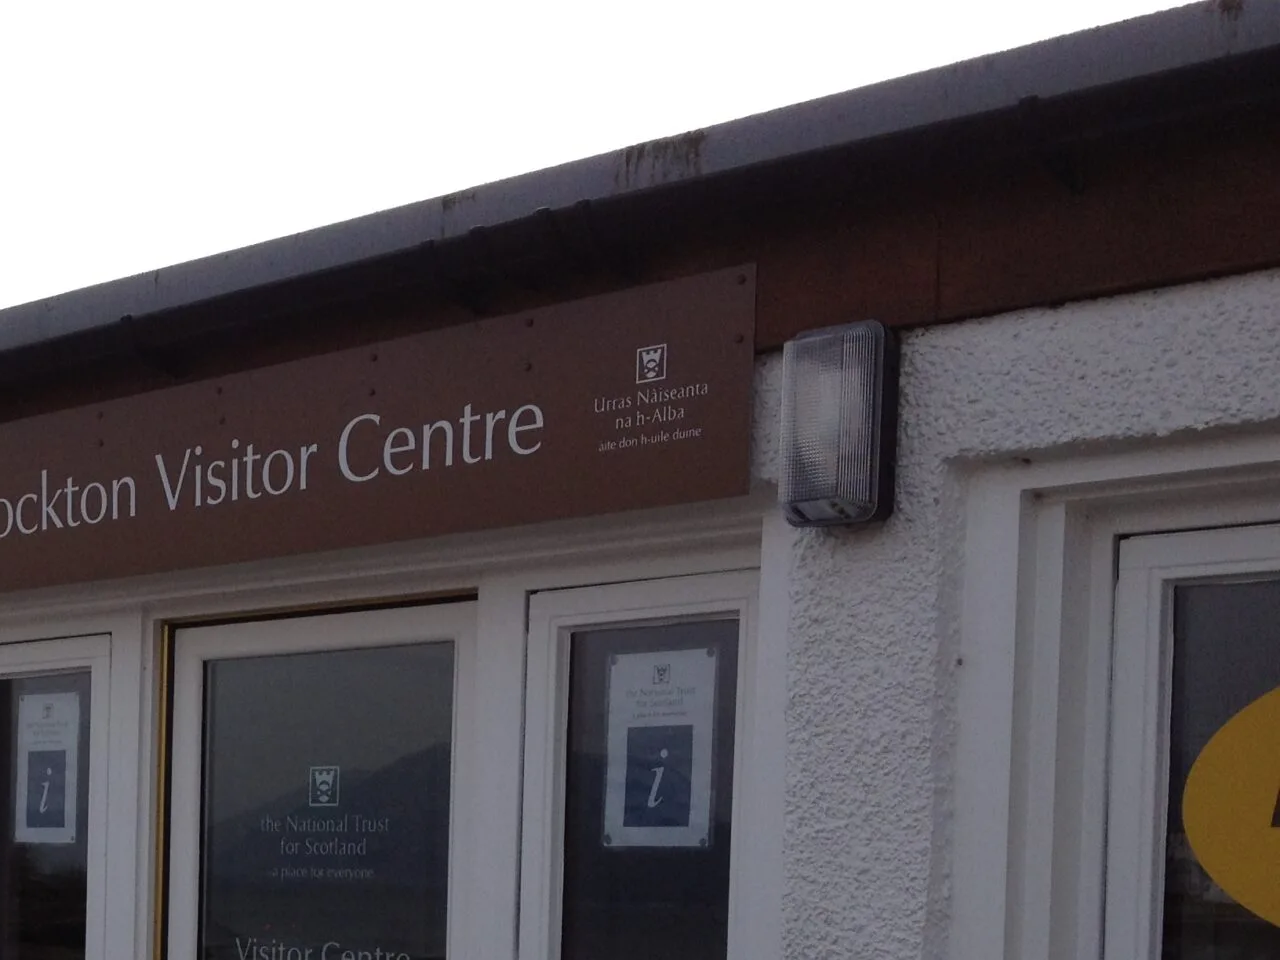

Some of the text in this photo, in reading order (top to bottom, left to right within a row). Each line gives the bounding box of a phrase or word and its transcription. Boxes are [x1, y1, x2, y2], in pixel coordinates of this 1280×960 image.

[594, 396, 632, 413] Urras
[615, 405, 685, 429] na h-Alba
[619, 437, 638, 449] don
[155, 439, 317, 511] Visitor
[338, 402, 544, 482] Centre
[260, 813, 390, 833] the National Trust
[280, 836, 367, 856] for Scotland
